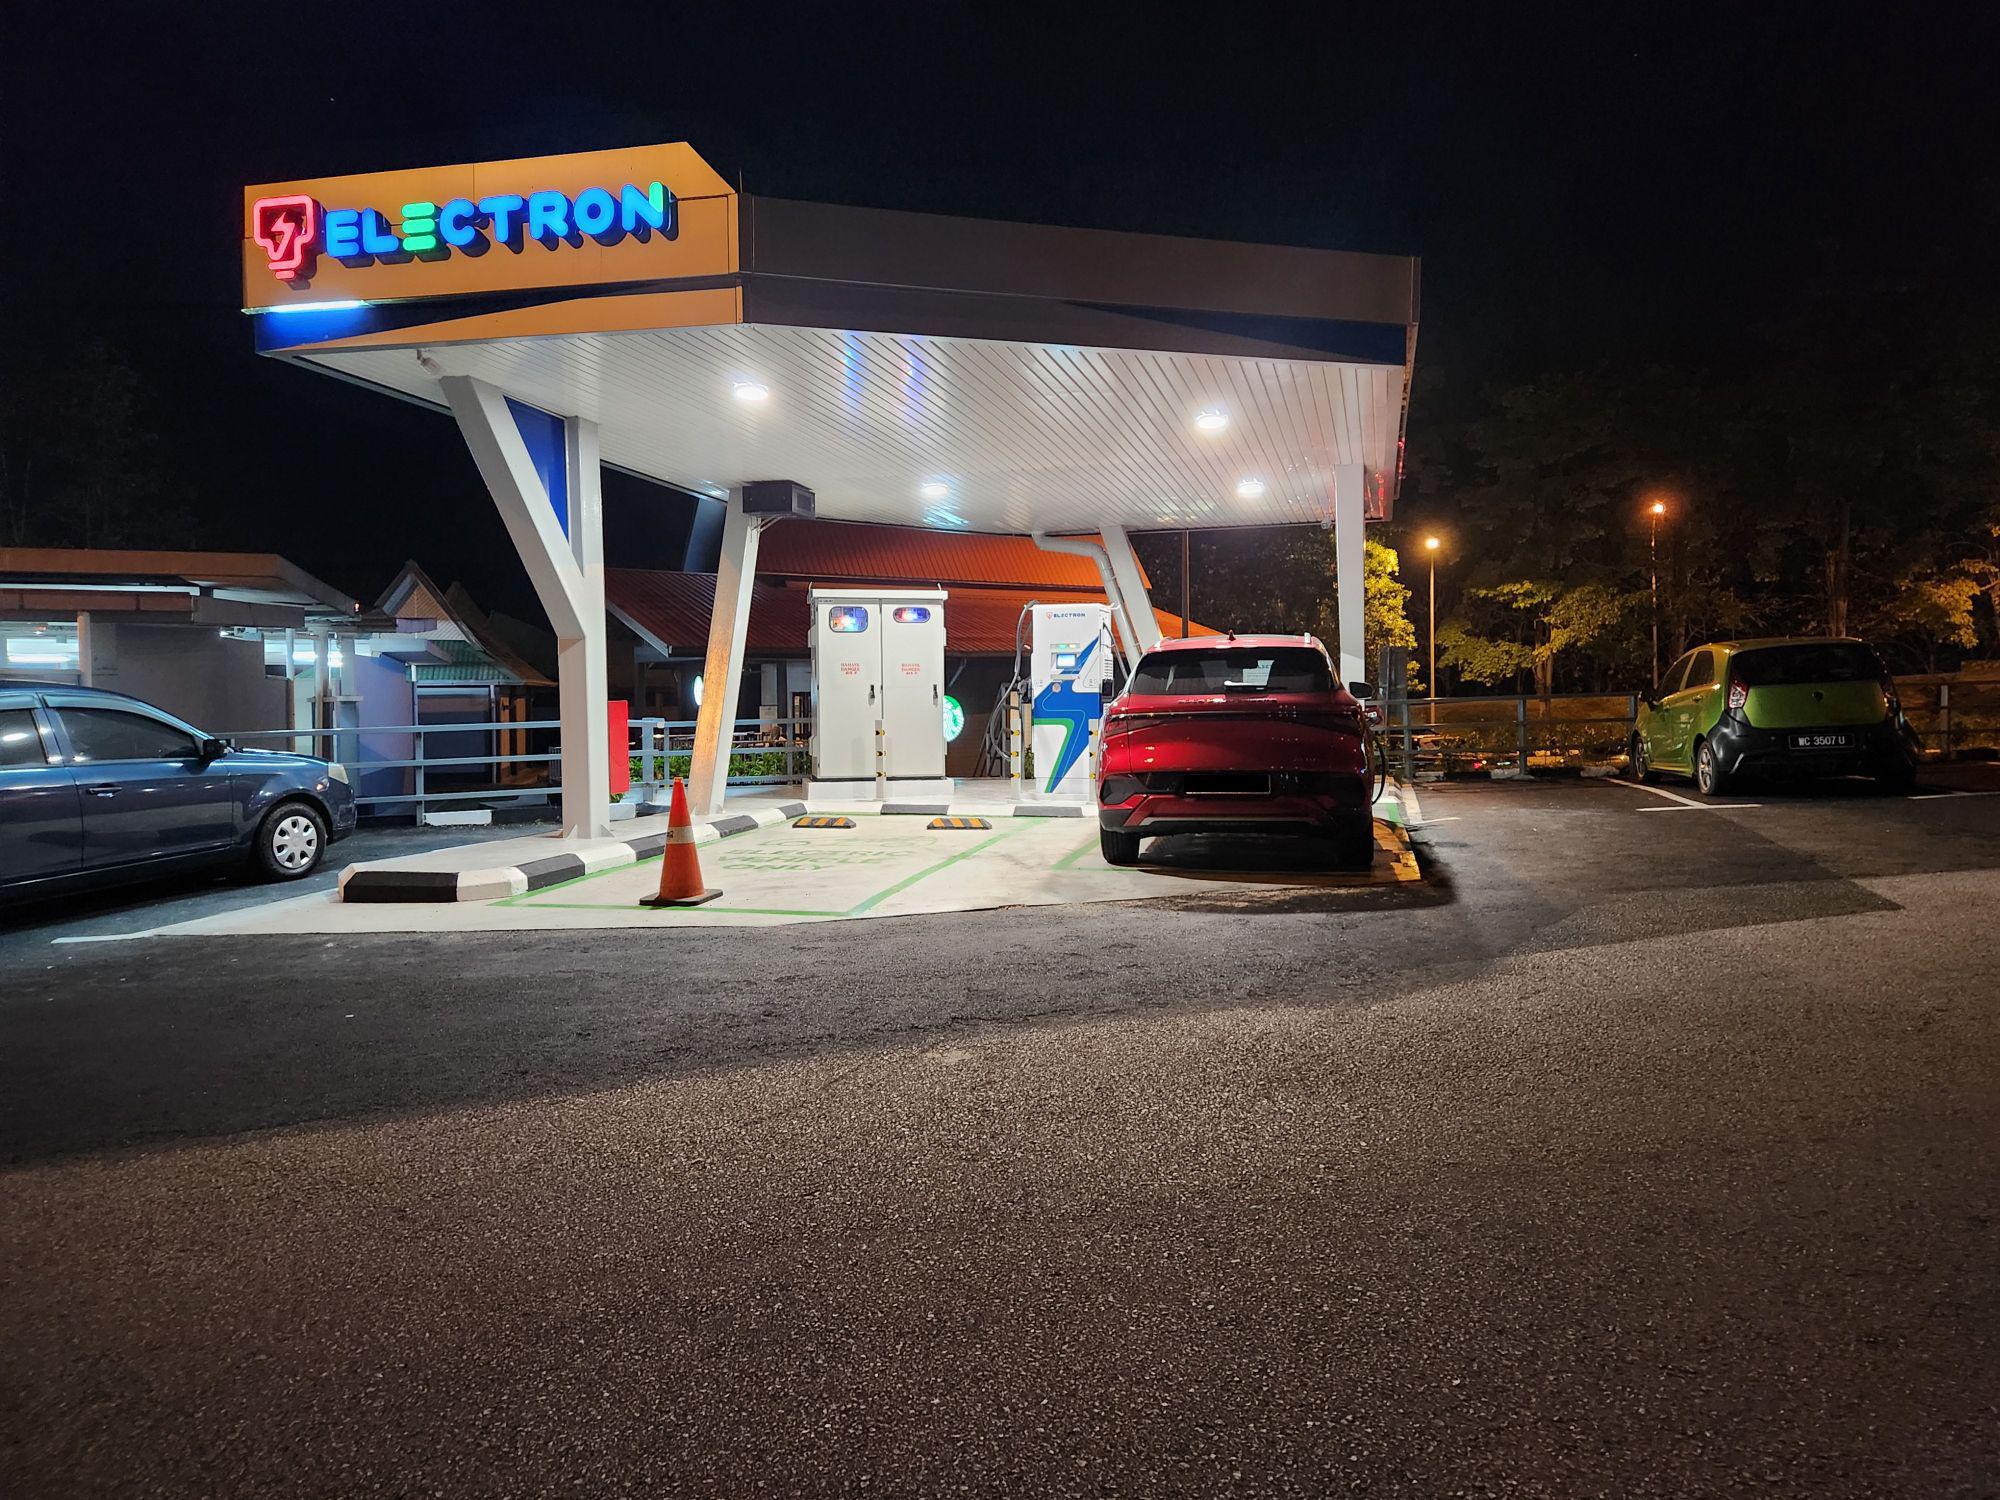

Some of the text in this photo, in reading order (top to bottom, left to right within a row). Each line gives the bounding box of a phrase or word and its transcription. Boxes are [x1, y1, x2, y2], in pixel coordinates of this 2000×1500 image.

[325, 180, 667, 259] ELECTRON
[1798, 735, 1846, 746] WC 3507 U
[725, 849, 914, 857] ELECTRIC
[718, 856, 896, 864] VEHICLE
[722, 863, 832, 871] ONLY
